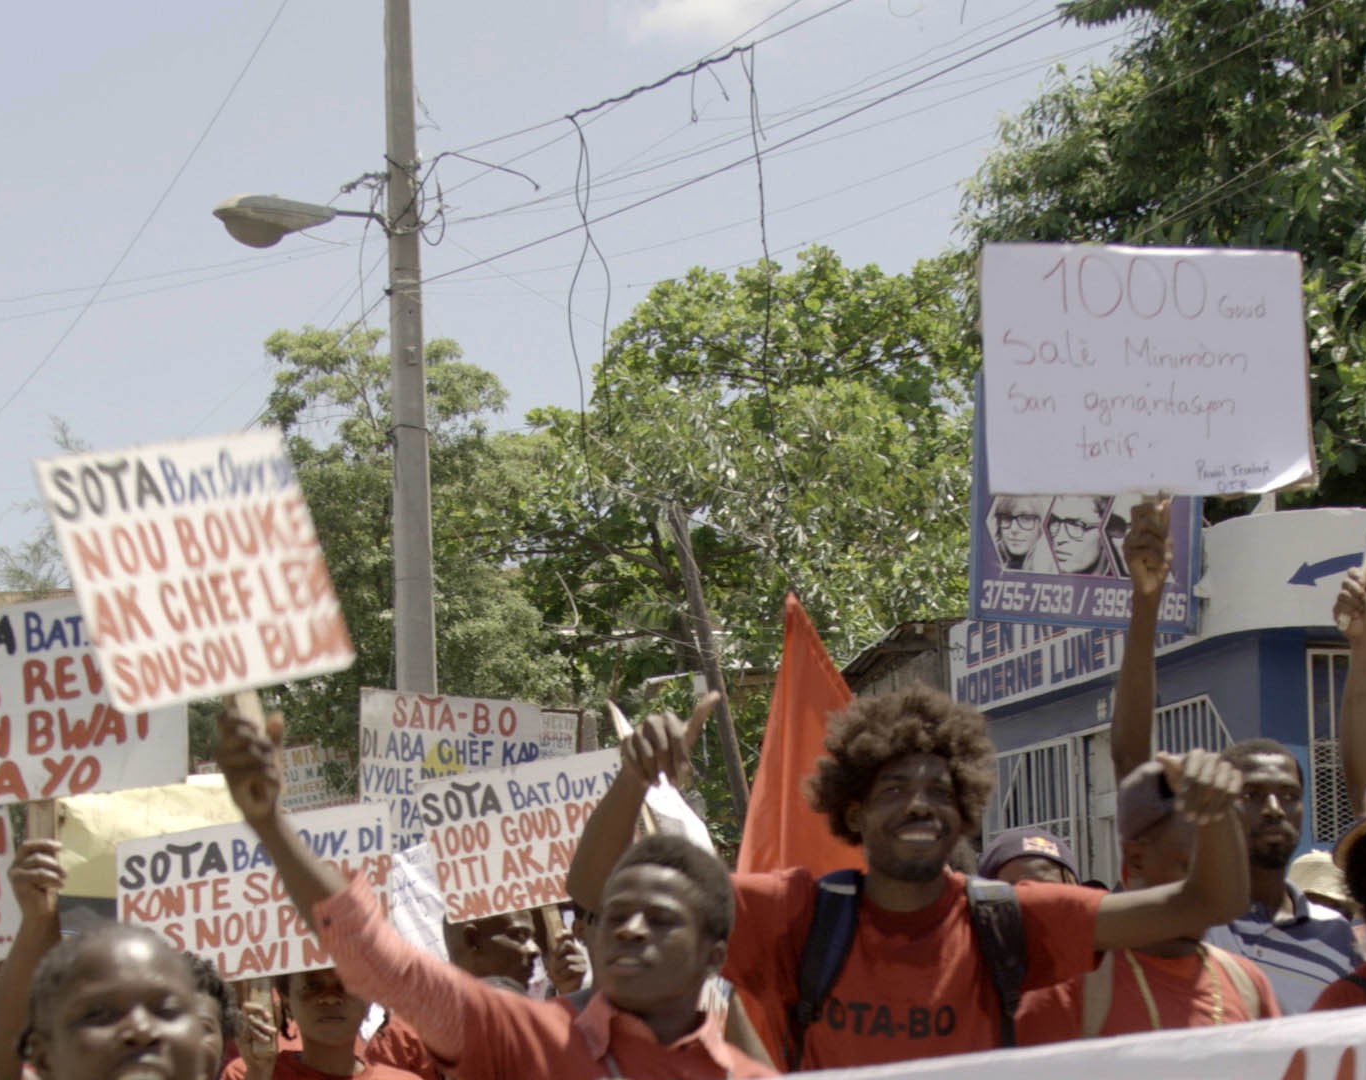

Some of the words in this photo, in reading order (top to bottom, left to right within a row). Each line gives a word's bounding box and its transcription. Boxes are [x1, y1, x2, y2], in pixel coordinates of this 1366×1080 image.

[1042, 254, 1208, 320] 1000
[51, 458, 165, 521] SOTA
[71, 518, 168, 582] NOU
[92, 585, 154, 648] AK
[158, 567, 253, 634] CHEF
[980, 579, 1075, 616] 3755-7533
[110, 631, 248, 706] SOUSOU
[956, 646, 1044, 705] MODERNE
[385, 731, 426, 764] ABA
[41, 754, 102, 798] YO
[421, 781, 503, 827] SOTA
[429, 820, 491, 860] 1000
[500, 807, 562, 847] GOUD
[118, 840, 228, 891] SOTA
[231, 838, 273, 872] BA
[436, 854, 490, 892] PITI
[502, 844, 546, 882] AK
[122, 876, 231, 924] KONTE
[195, 908, 268, 952] NOU
[825, 996, 957, 1040] OTA-BO
